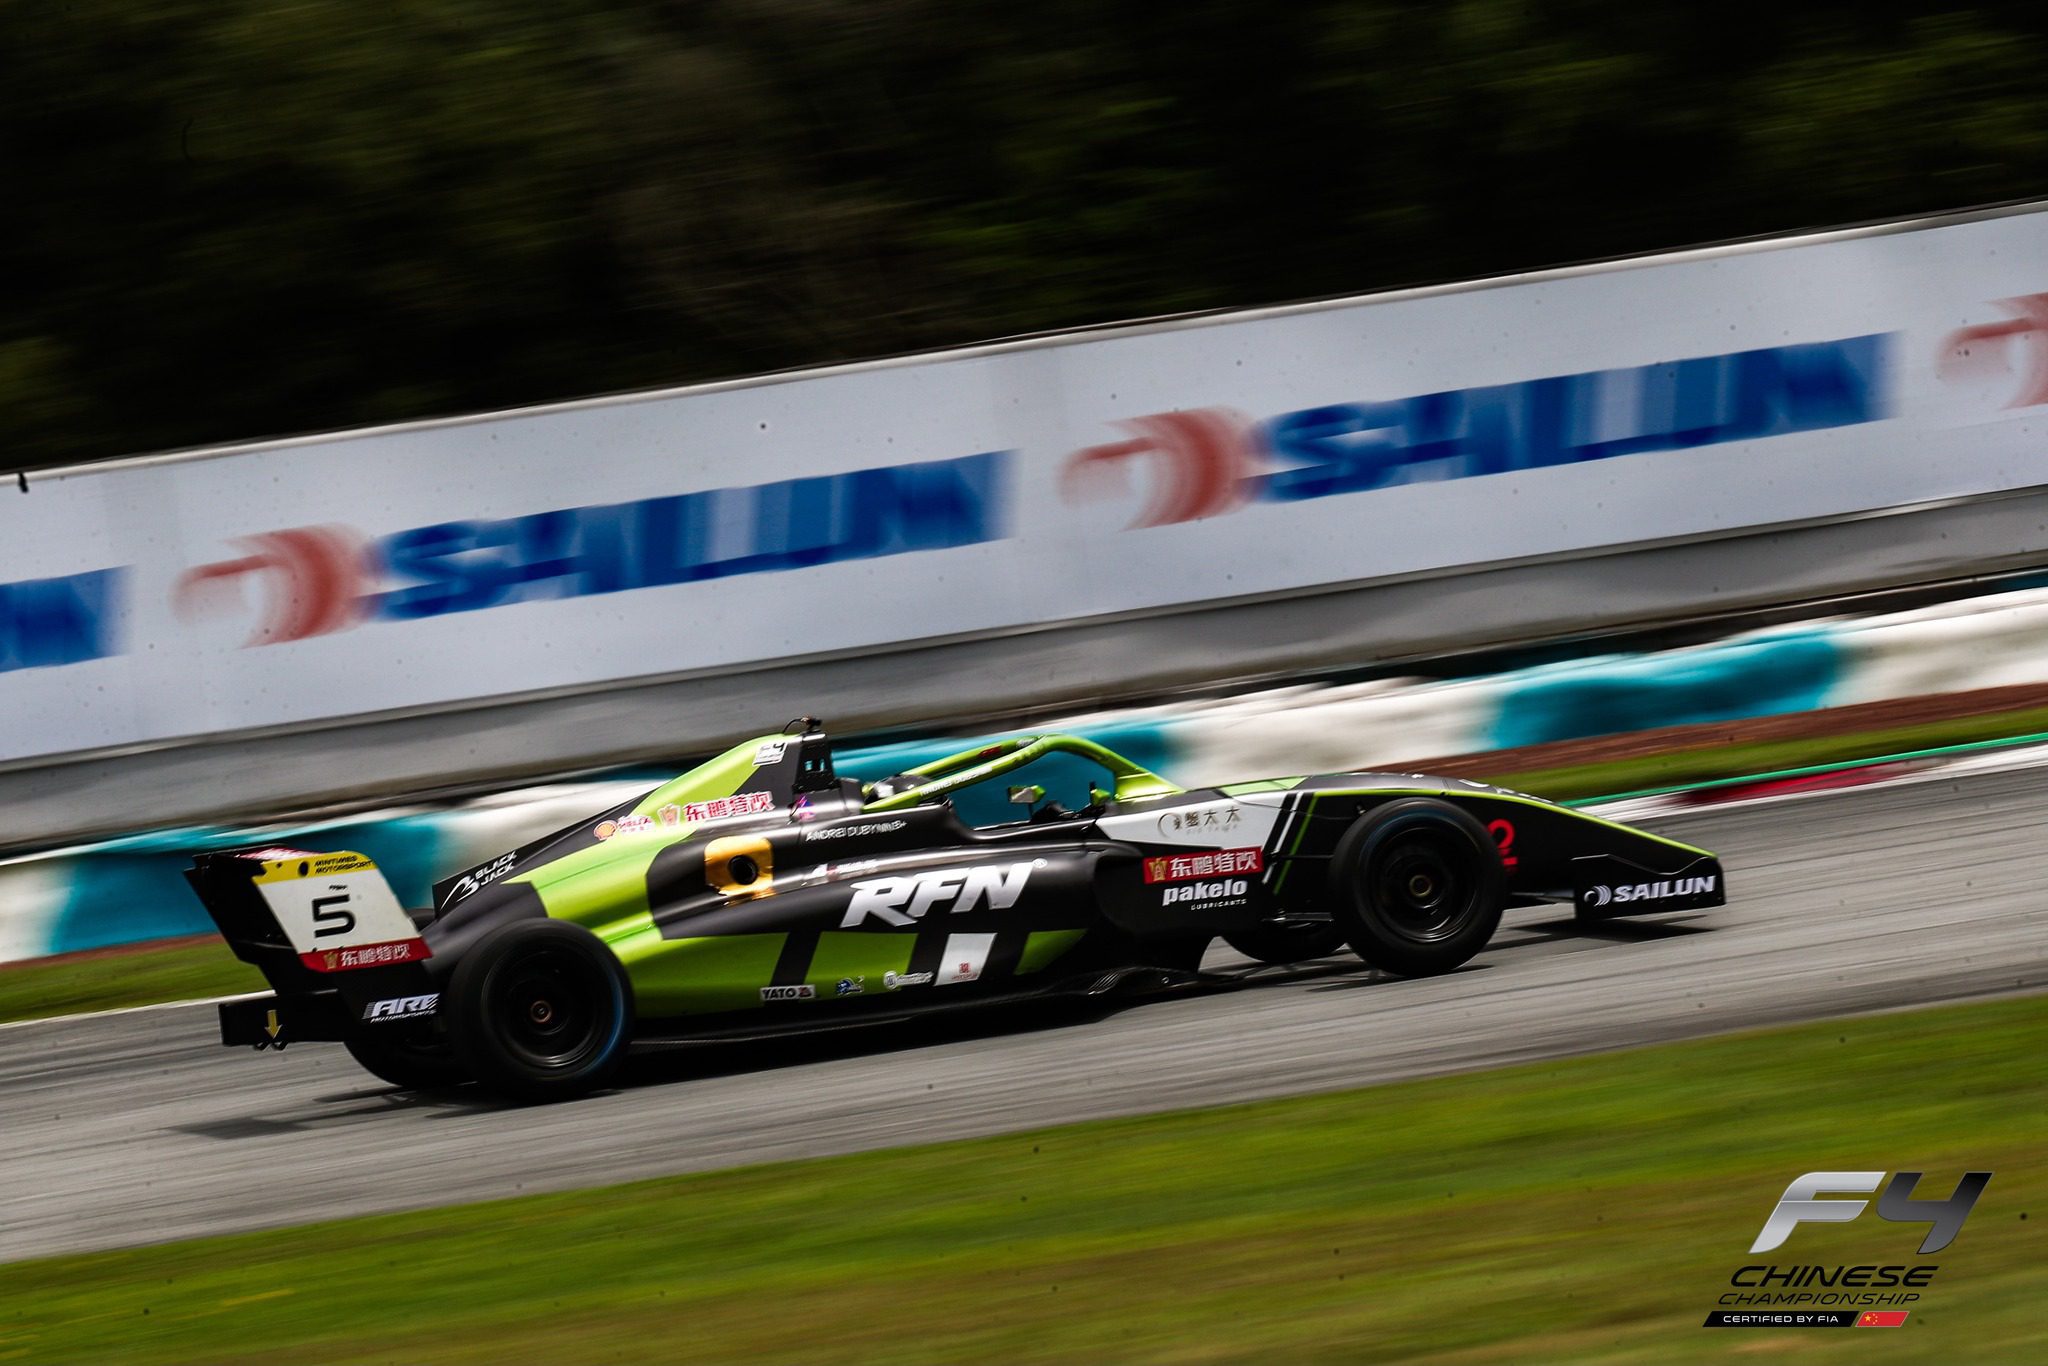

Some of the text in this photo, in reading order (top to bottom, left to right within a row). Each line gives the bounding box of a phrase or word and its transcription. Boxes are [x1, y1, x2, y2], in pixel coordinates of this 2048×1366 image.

[475, 851, 517, 879] BLACK
[481, 862, 515, 886] JACK
[1169, 851, 1258, 878] 东鹏特饮
[839, 861, 1035, 928] RFN
[1162, 879, 1248, 906] pakelo
[1613, 875, 1716, 902] SAILUN
[312, 894, 356, 938] 5
[762, 987, 797, 999] YATO
